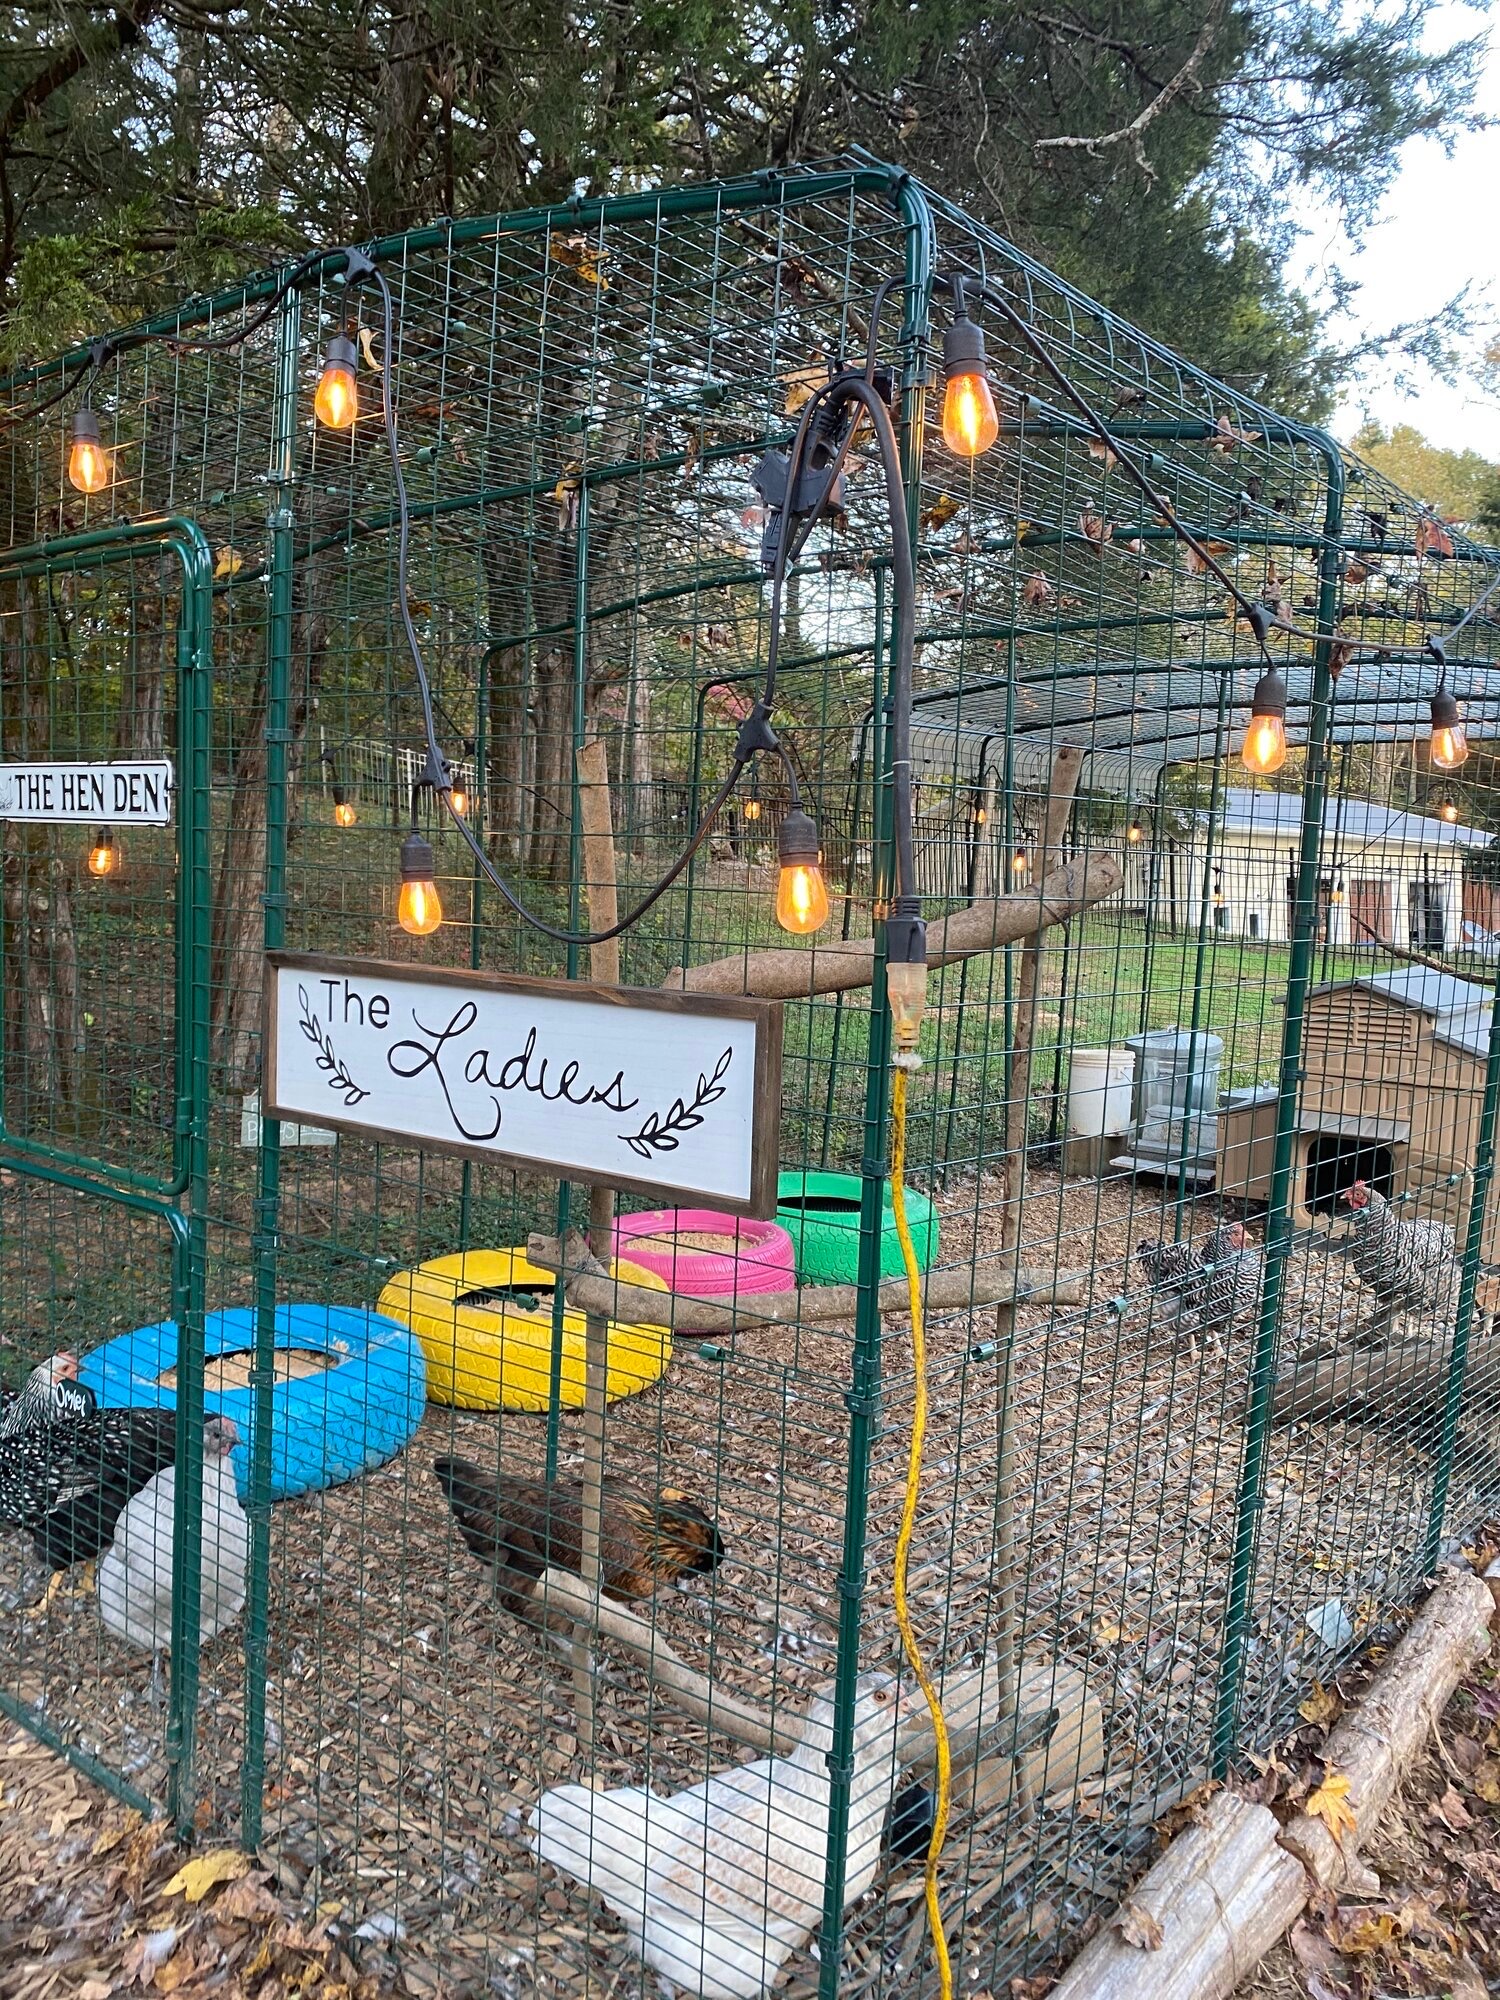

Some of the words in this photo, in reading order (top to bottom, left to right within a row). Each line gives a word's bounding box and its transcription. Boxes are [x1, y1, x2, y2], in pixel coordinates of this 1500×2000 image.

[14, 774, 54, 810] THE
[61, 773, 105, 812] HEN
[113, 773, 160, 814] DEN
[320, 979, 391, 1029] The
[387, 1001, 639, 1141] Ladies
[56, 1382, 86, 1418] Omlet
